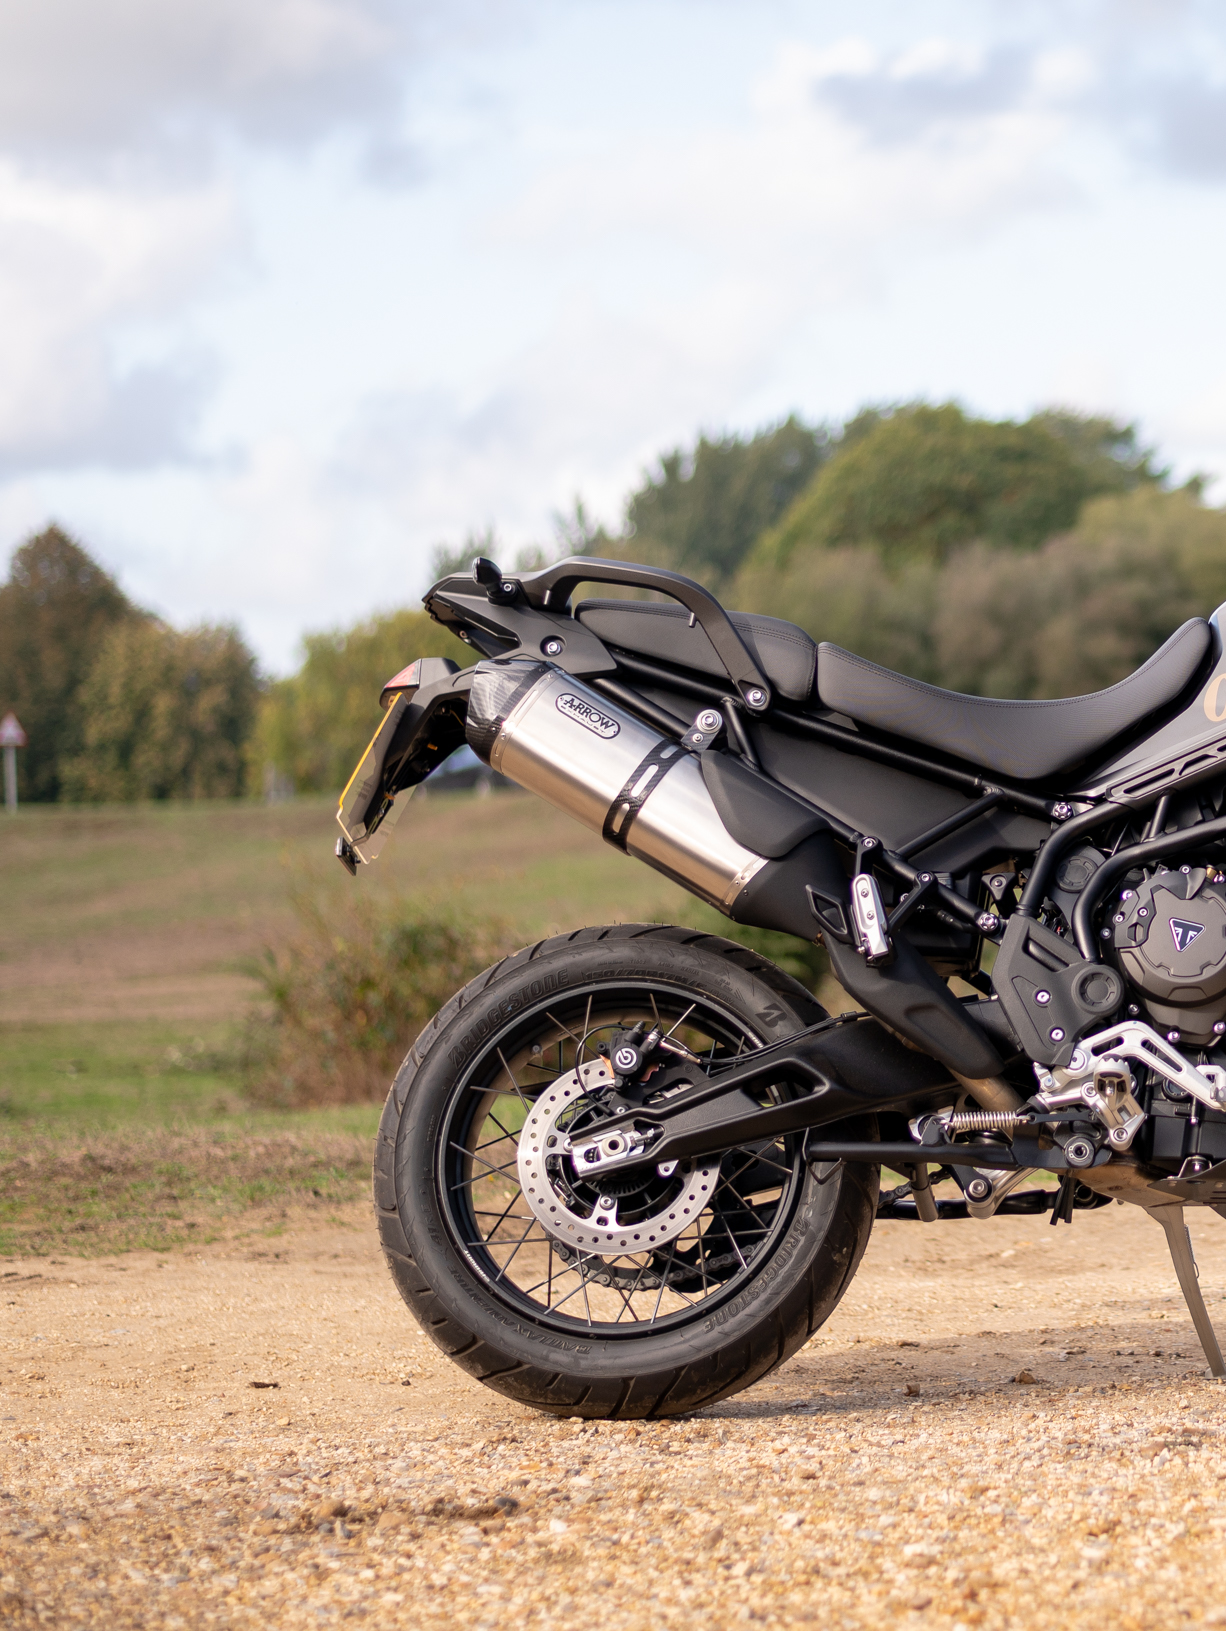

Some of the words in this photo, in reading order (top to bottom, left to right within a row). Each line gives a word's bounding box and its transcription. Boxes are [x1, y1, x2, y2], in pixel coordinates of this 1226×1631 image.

[563, 697, 616, 730] ARROW
[447, 967, 570, 1069] BRIDGESTONE
[704, 1217, 811, 1335] BRIDGESTONE
